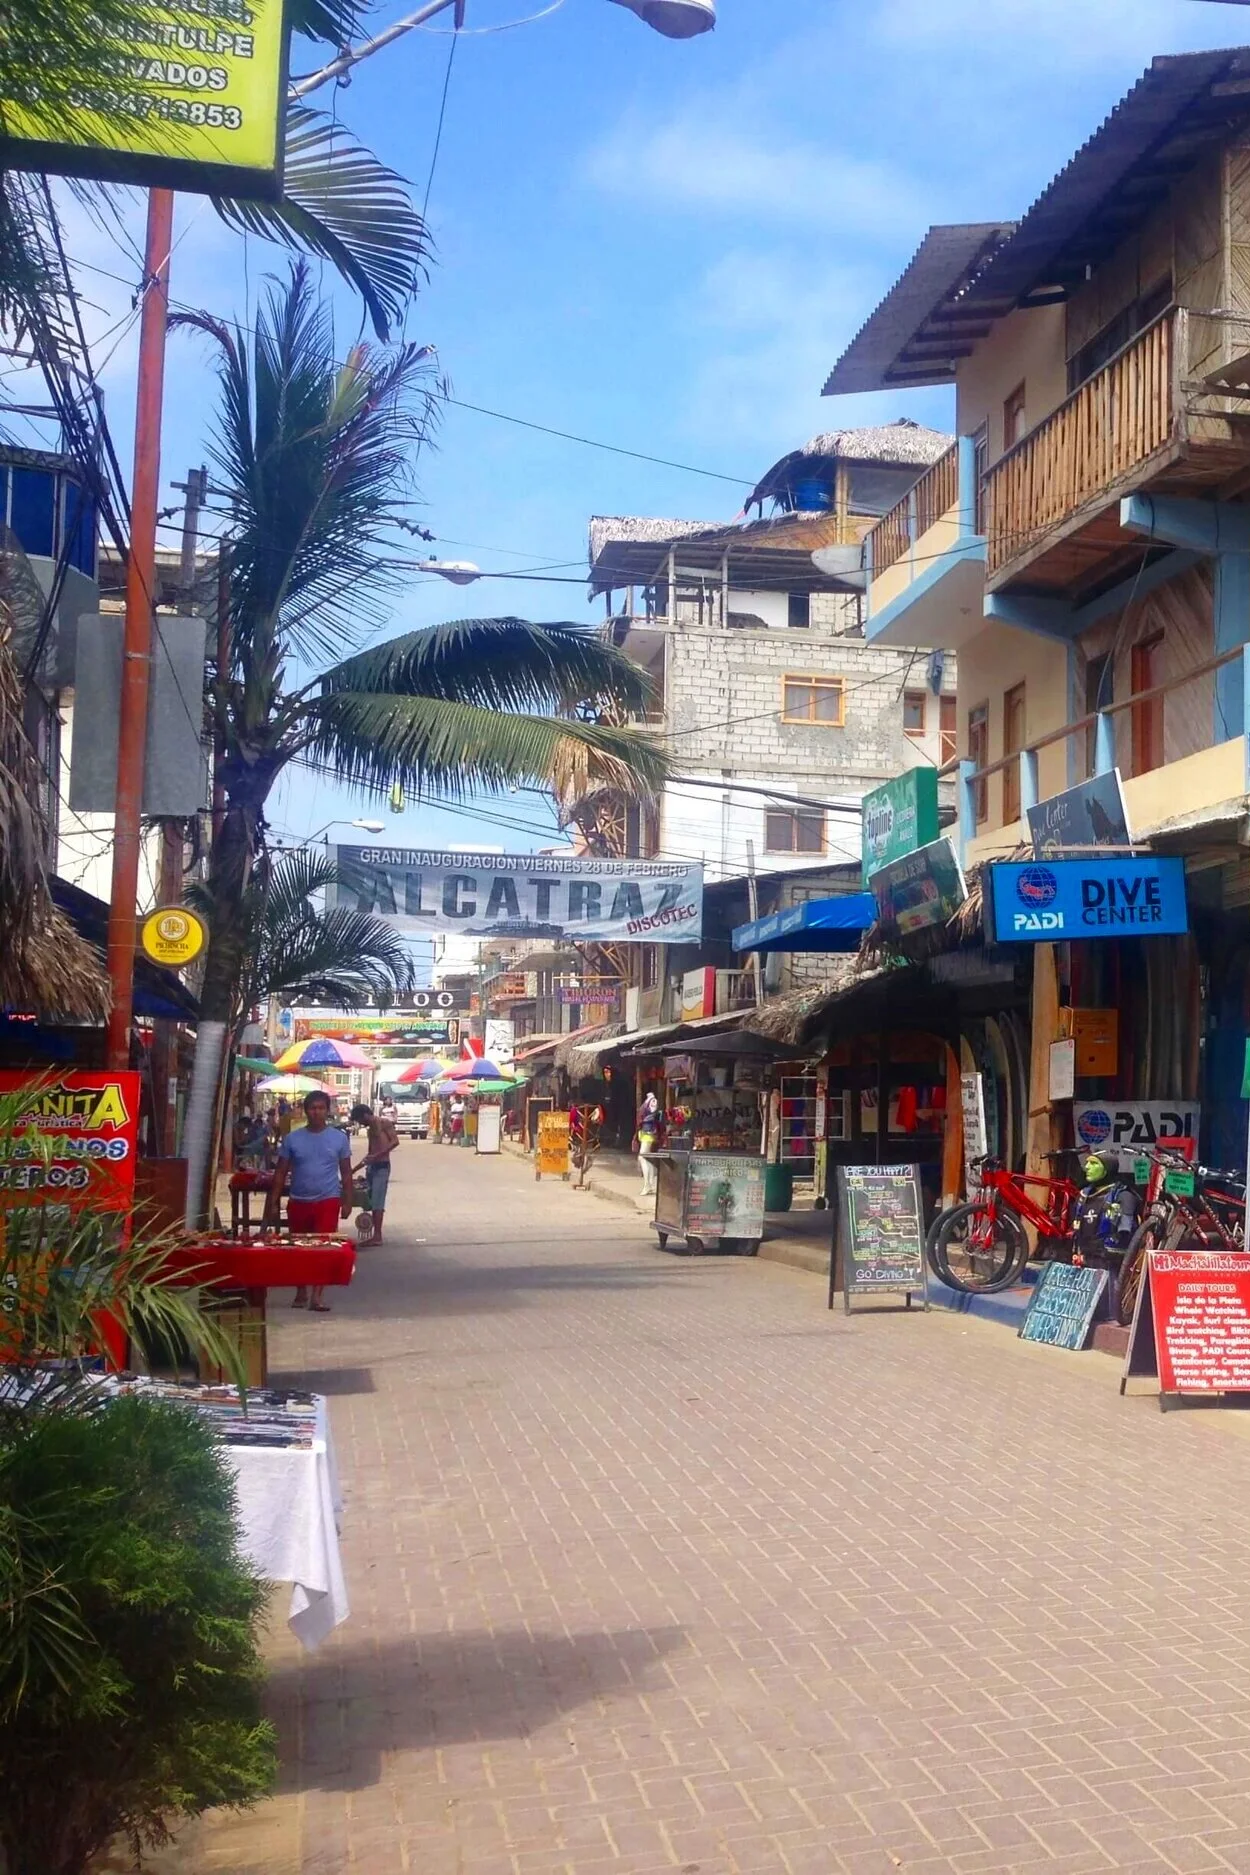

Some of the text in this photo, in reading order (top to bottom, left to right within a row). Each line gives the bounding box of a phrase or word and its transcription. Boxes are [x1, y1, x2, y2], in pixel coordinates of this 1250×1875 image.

[360, 849, 689, 878] GRAN INAUGURACION VIERNES 28 DE FEBRERO
[355, 870, 683, 921] ALCATRAZ
[1081, 877, 1162, 908] DIVE
[626, 903, 698, 935] DISCOTEC
[1081, 904, 1163, 925] CENTER
[1013, 911, 1064, 931] PADI
[1113, 1111, 1192, 1143] PADI
[846, 1166, 863, 1176] ARE
[867, 1166, 881, 1176] YOU
[856, 1269, 872, 1279] GO
[1178, 1283, 1237, 1293] DAILY TOURS
[1194, 1296, 1206, 1305] de
[1208, 1296, 1217, 1305] la
[1174, 1306, 1247, 1317] Whale Watching
[1203, 1316, 1222, 1325] Surf
[1166, 1326, 1185, 1335] Bird
[1202, 1347, 1224, 1355] PADI
[1173, 1367, 1200, 1376] Horse
